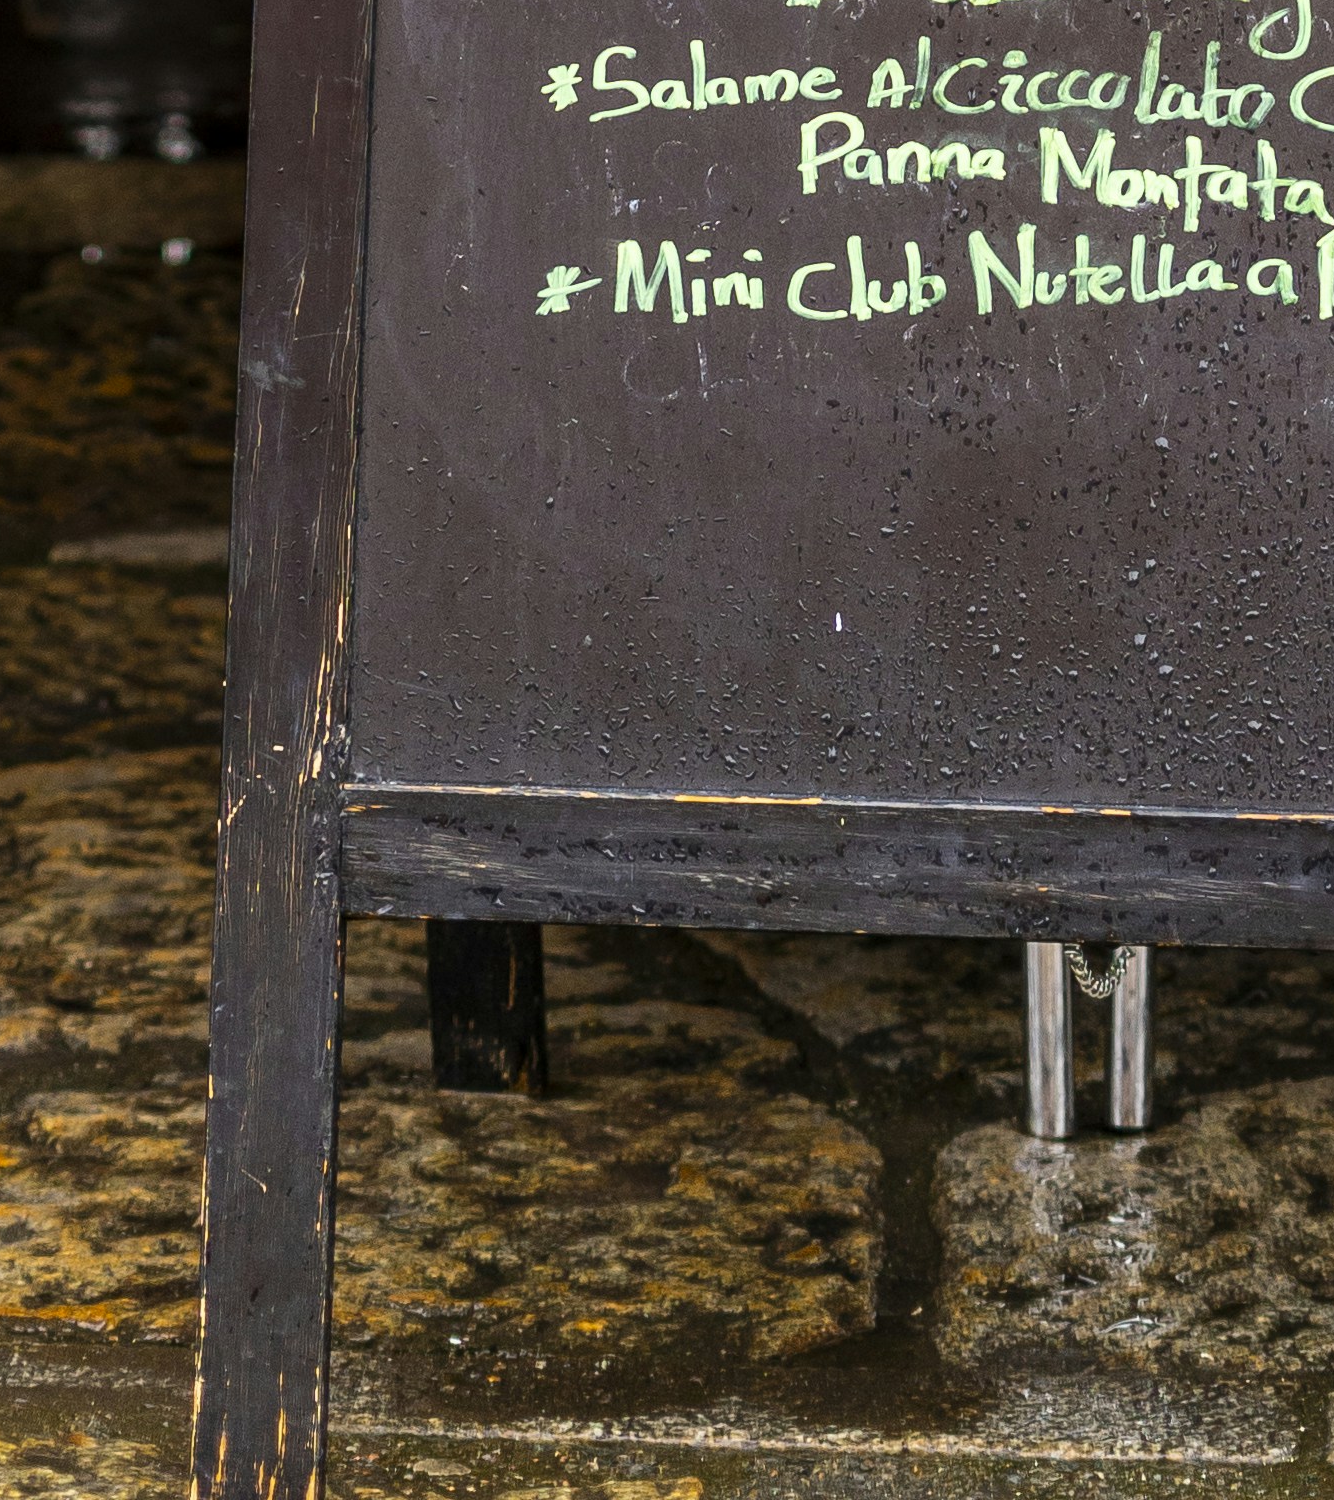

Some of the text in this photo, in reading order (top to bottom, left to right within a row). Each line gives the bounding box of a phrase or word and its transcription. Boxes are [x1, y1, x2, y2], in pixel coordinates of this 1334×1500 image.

[587, 39, 843, 124] Salame
[797, 110, 1007, 196] Panna
[612, 238, 765, 325] Mini
[967, 224, 1238, 318] Nutella
[1244, 256, 1300, 307] a
